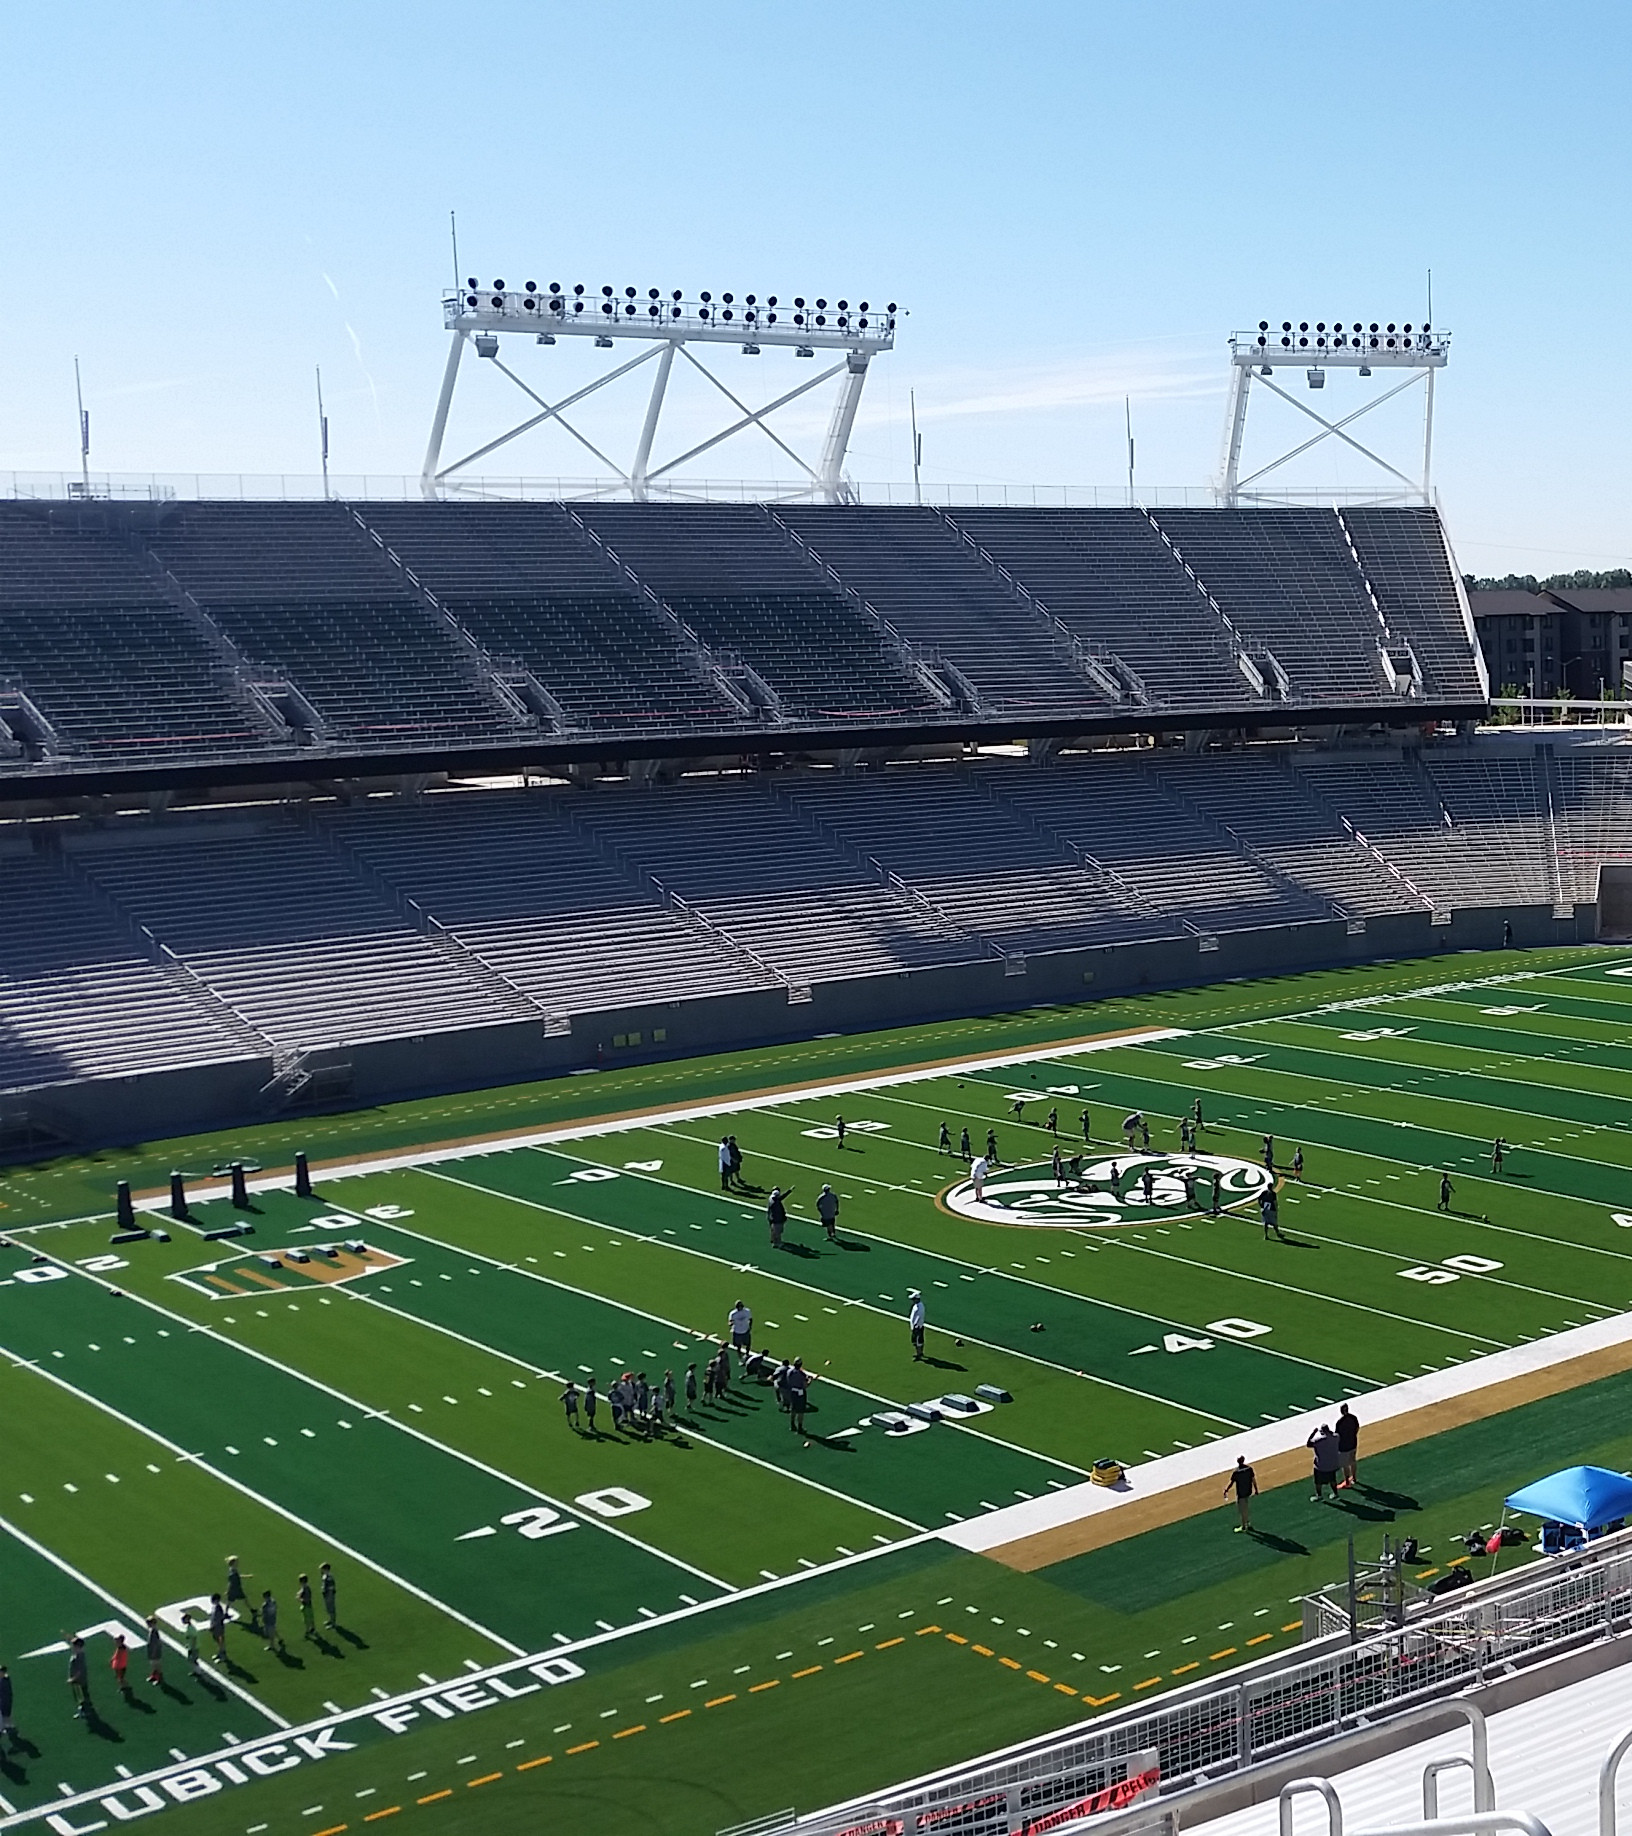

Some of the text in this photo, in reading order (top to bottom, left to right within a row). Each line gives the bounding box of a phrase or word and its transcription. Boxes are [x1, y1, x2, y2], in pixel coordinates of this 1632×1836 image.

[1338, 1028, 1407, 1042] 20
[1181, 1054, 1256, 1071] 30
[1003, 1084, 1081, 1102] 40
[569, 1159, 664, 1182] 40
[309, 1204, 415, 1230] 30
[12, 1254, 130, 1284] 20
[1396, 1253, 1505, 1286] 50
[1163, 1317, 1274, 1354] 40
[500, 1486, 653, 1540] 20
[46, 1657, 586, 1836] LUBICK FIELD
[1035, 1803, 1086, 1834] DANGER
